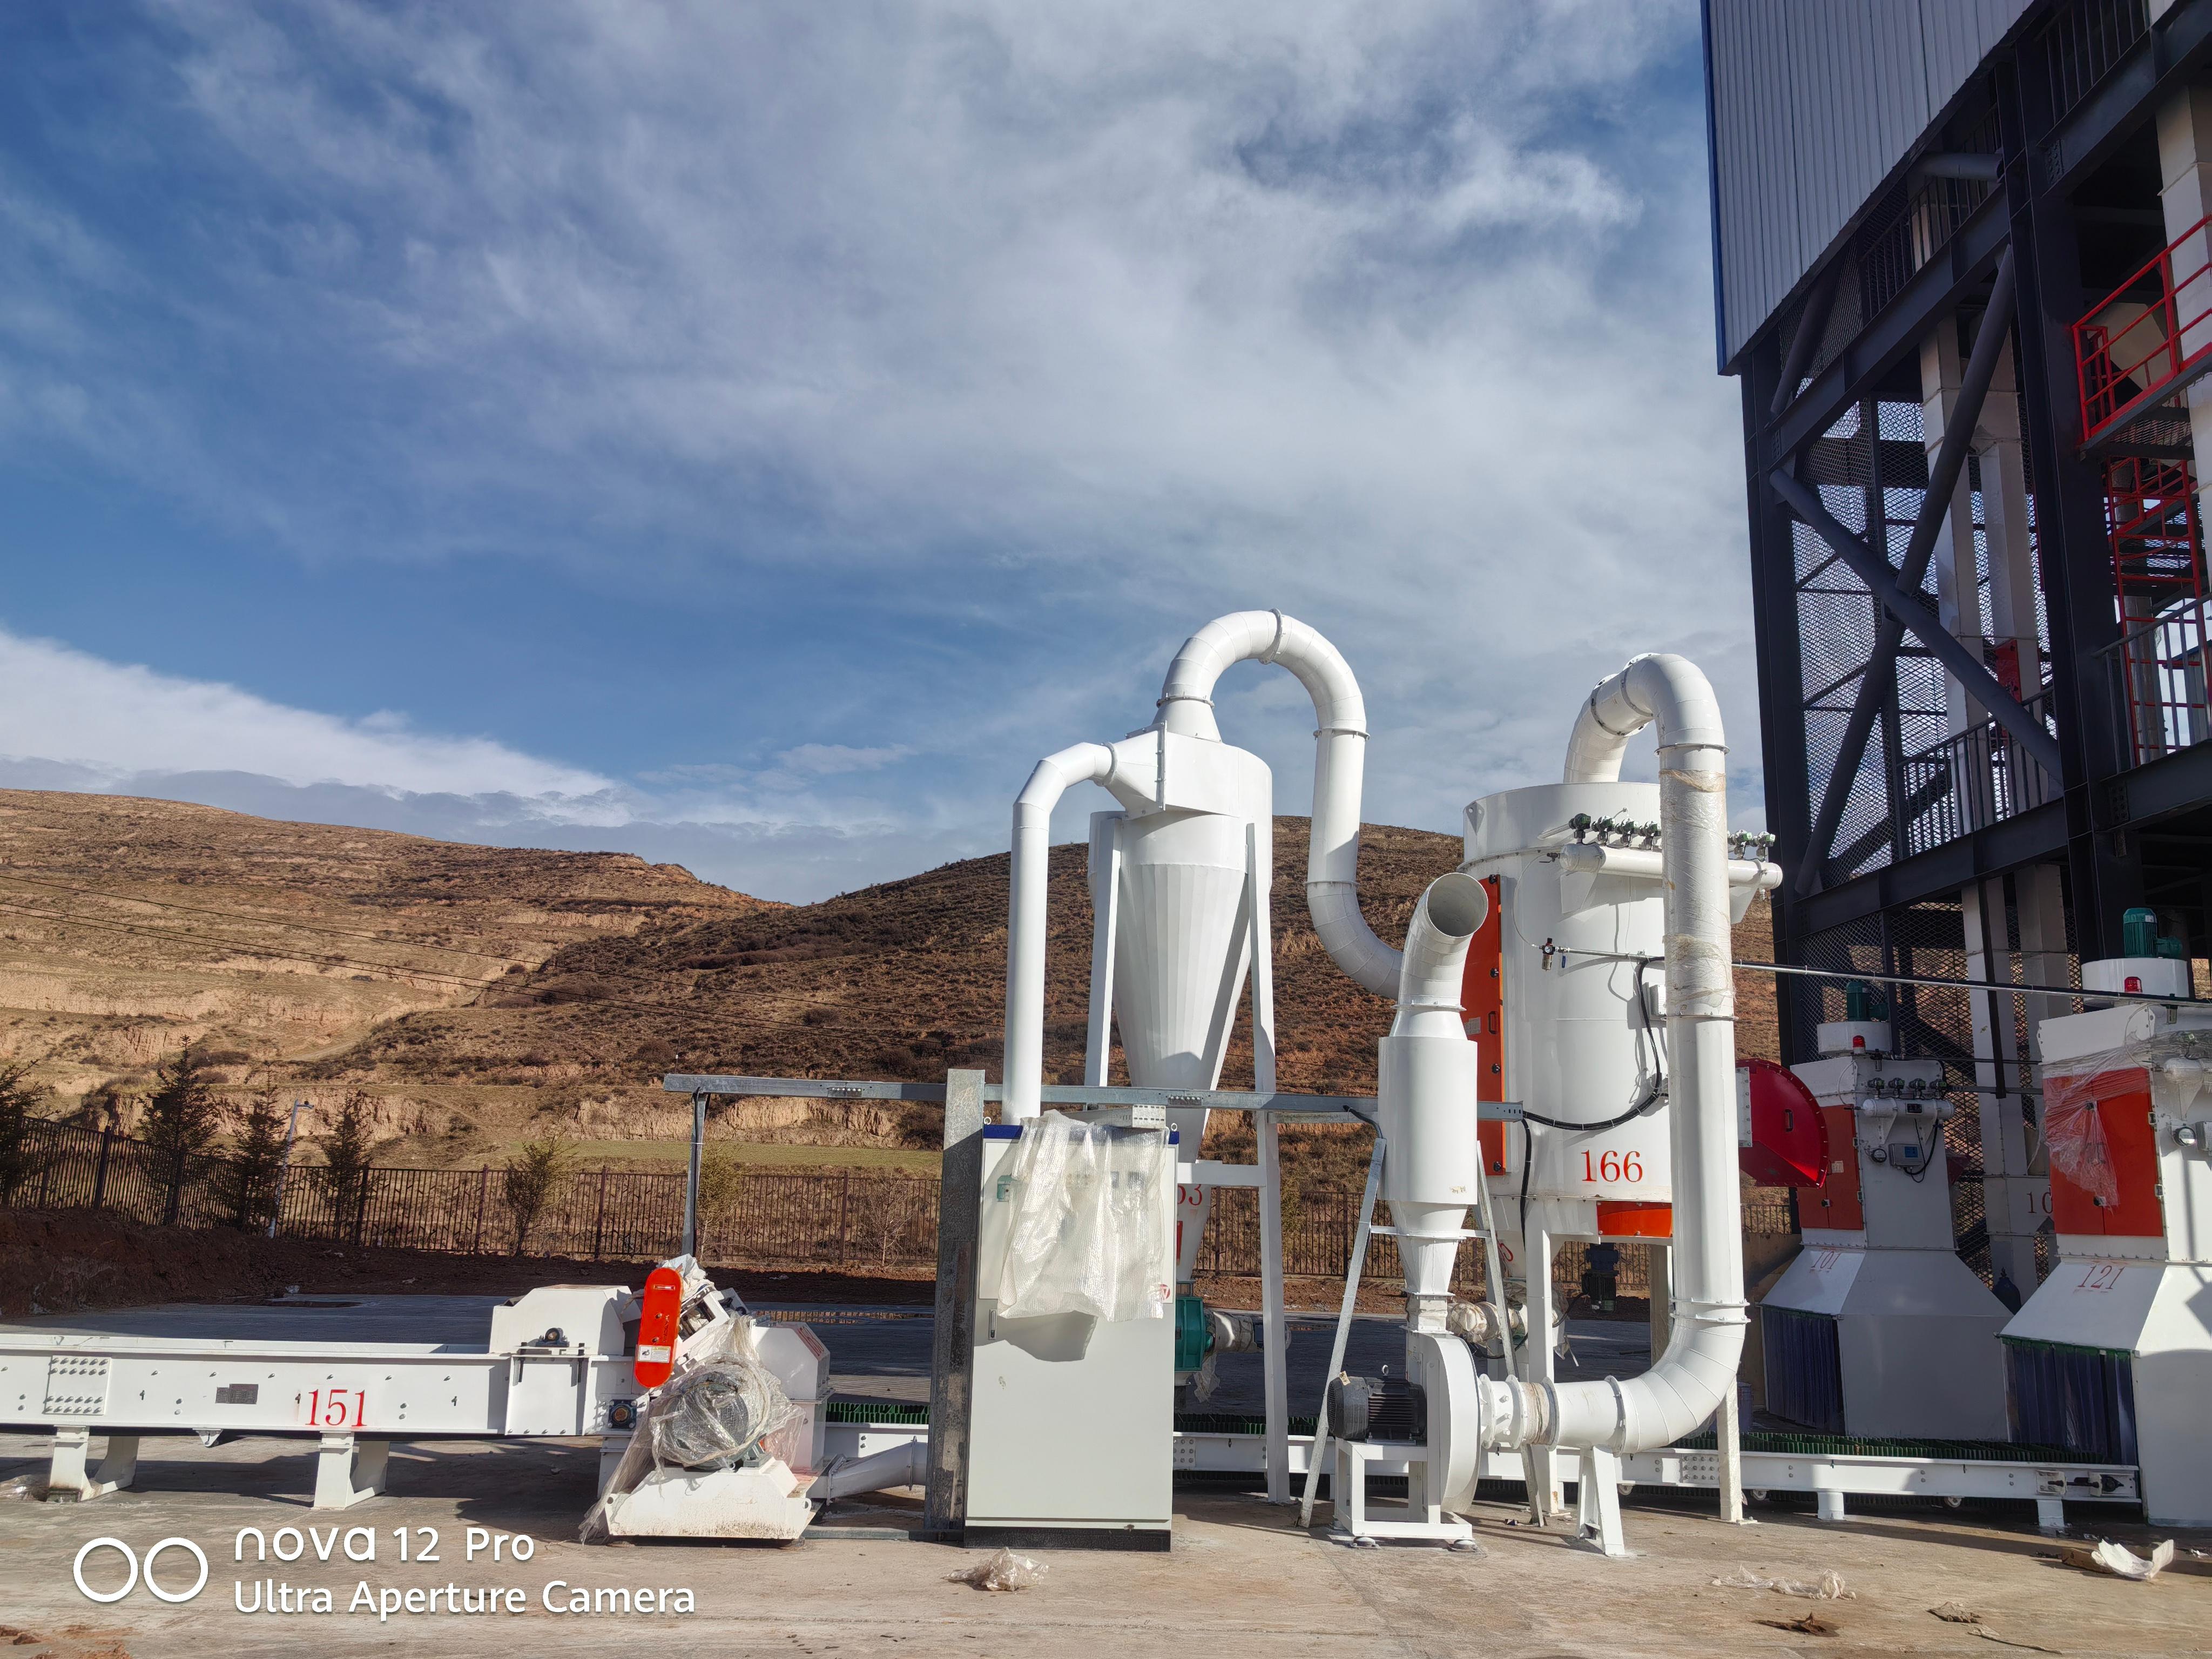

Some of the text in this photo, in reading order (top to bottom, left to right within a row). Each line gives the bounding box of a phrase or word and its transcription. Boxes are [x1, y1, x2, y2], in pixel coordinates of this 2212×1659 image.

[1581, 1149, 1643, 1183] 166
[2078, 1265, 2126, 1289] 121
[305, 1389, 367, 1427] 151
